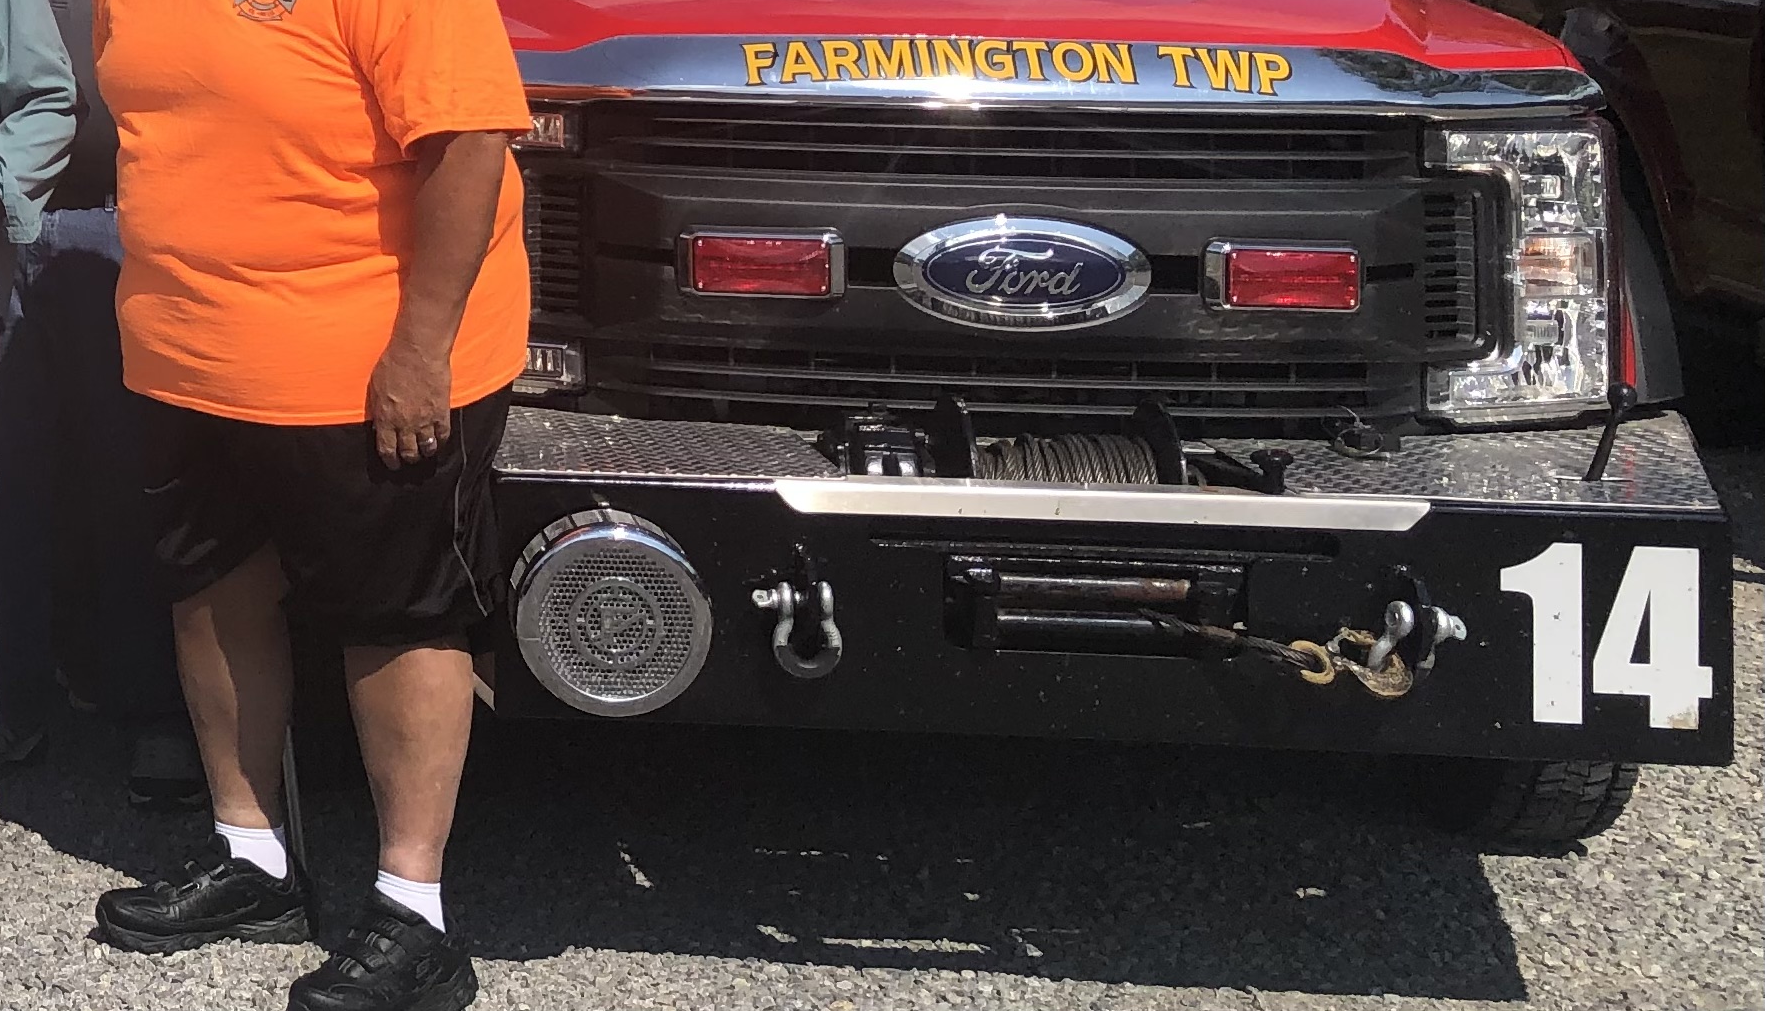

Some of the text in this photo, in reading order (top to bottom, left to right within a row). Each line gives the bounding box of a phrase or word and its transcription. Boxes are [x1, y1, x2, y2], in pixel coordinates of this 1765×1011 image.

[742, 39, 1292, 96] FARMINGTON TWP
[966, 245, 1084, 295] Ford
[1500, 542, 1713, 730] 14
